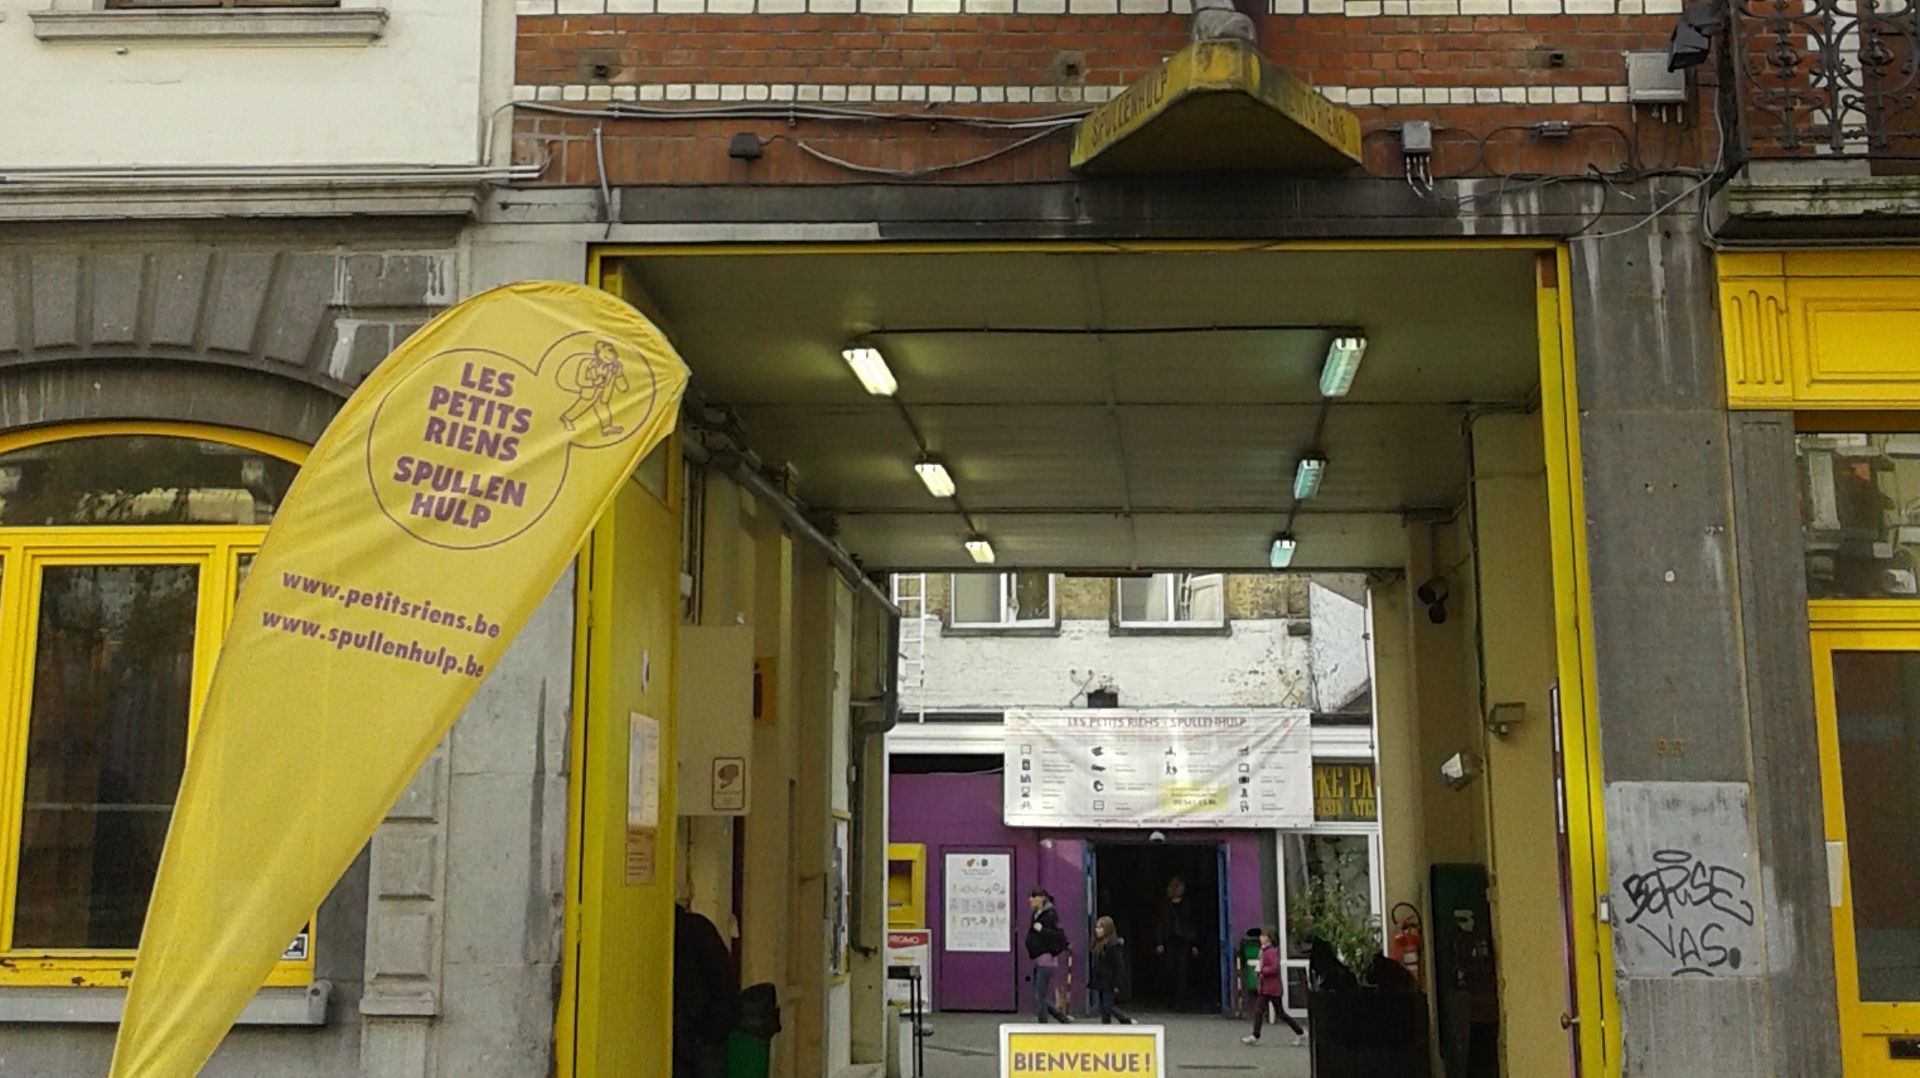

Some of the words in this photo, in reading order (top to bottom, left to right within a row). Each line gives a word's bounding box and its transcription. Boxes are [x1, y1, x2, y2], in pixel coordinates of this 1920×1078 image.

[460, 361, 515, 398] LES
[428, 385, 533, 434] PETITS
[424, 416, 520, 462] RIENS
[393, 455, 528, 508] SPULLEN
[410, 492, 492, 529] HULP
[282, 571, 501, 639] www.petitsriens.be
[261, 610, 485, 679] www.spullenhulp.be
[1067, 716, 1086, 728] LES
[1089, 716, 1124, 728] PETITS
[1127, 716, 1159, 728] RIENS
[1170, 716, 1247, 728] SPULLENHULP
[1013, 1052, 1140, 1072] BIENVENUE
[1145, 1052, 1151, 1072] !
